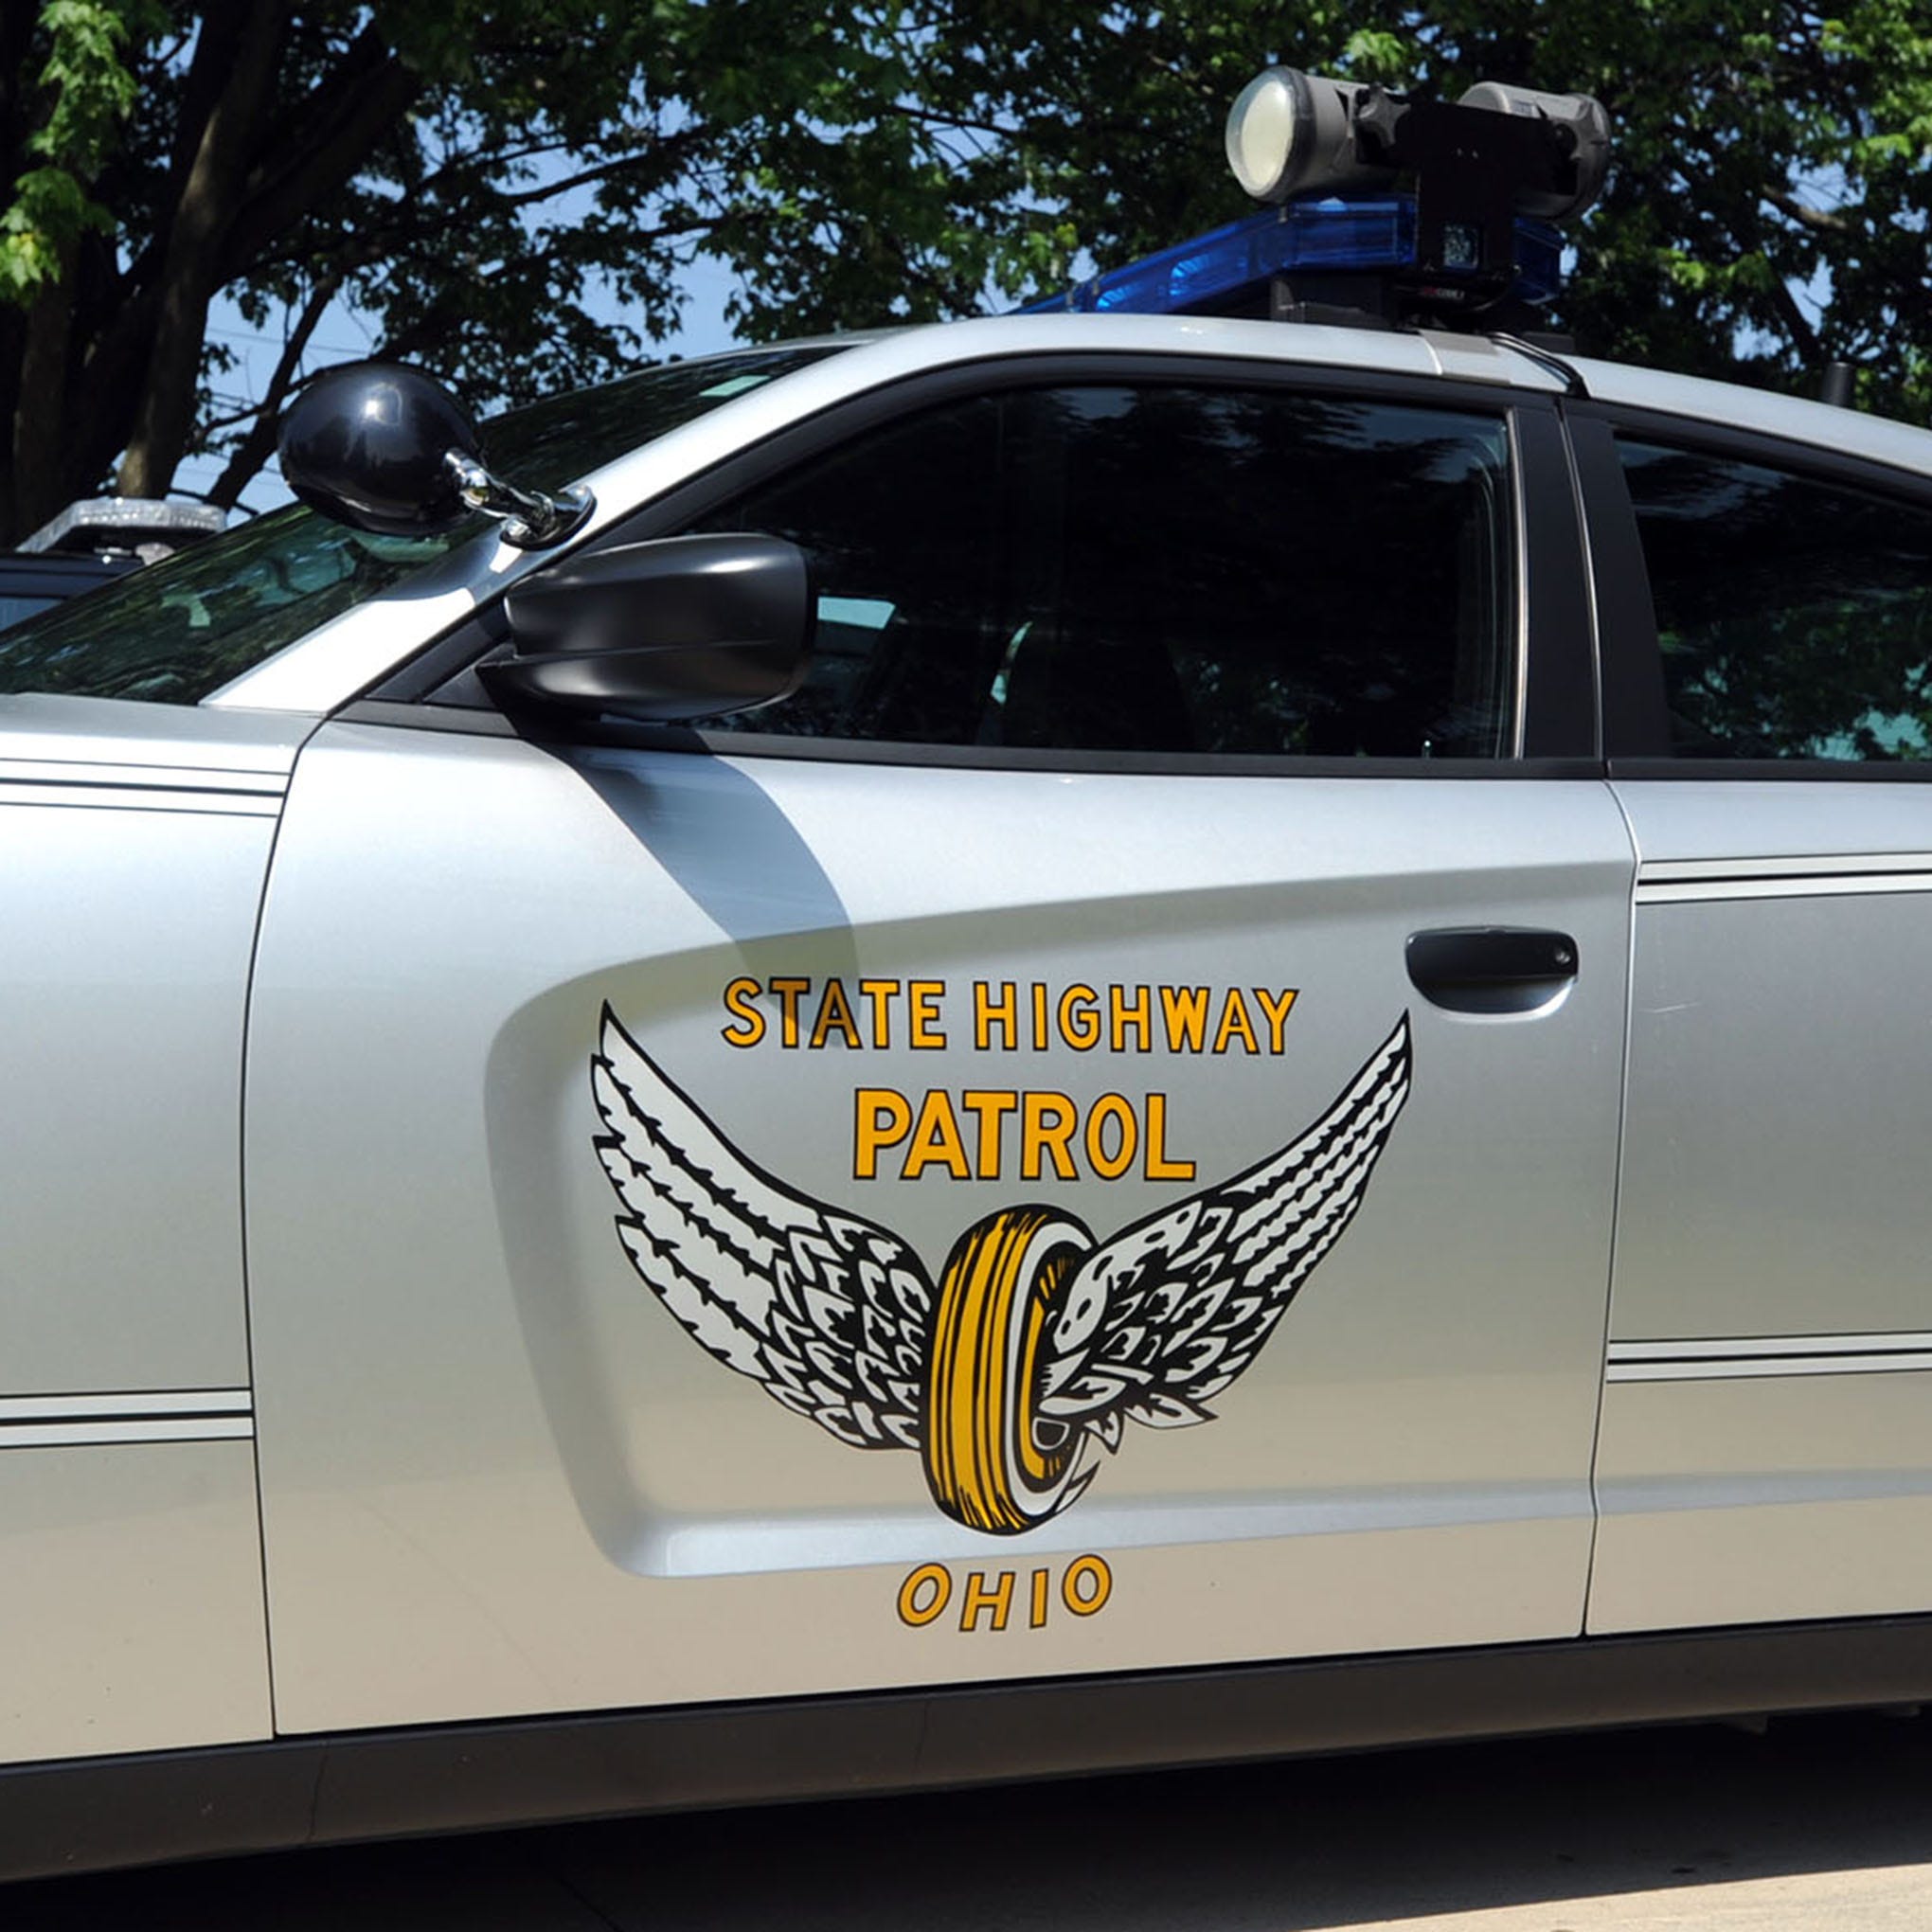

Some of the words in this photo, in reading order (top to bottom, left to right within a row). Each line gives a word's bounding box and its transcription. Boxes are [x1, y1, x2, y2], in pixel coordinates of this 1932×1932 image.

[722, 976, 947, 1049] STATE
[974, 981, 1298, 1055] HIGHWAY
[853, 1088, 1197, 1181] PATROL
[897, 1554, 1113, 1632] OHIO
